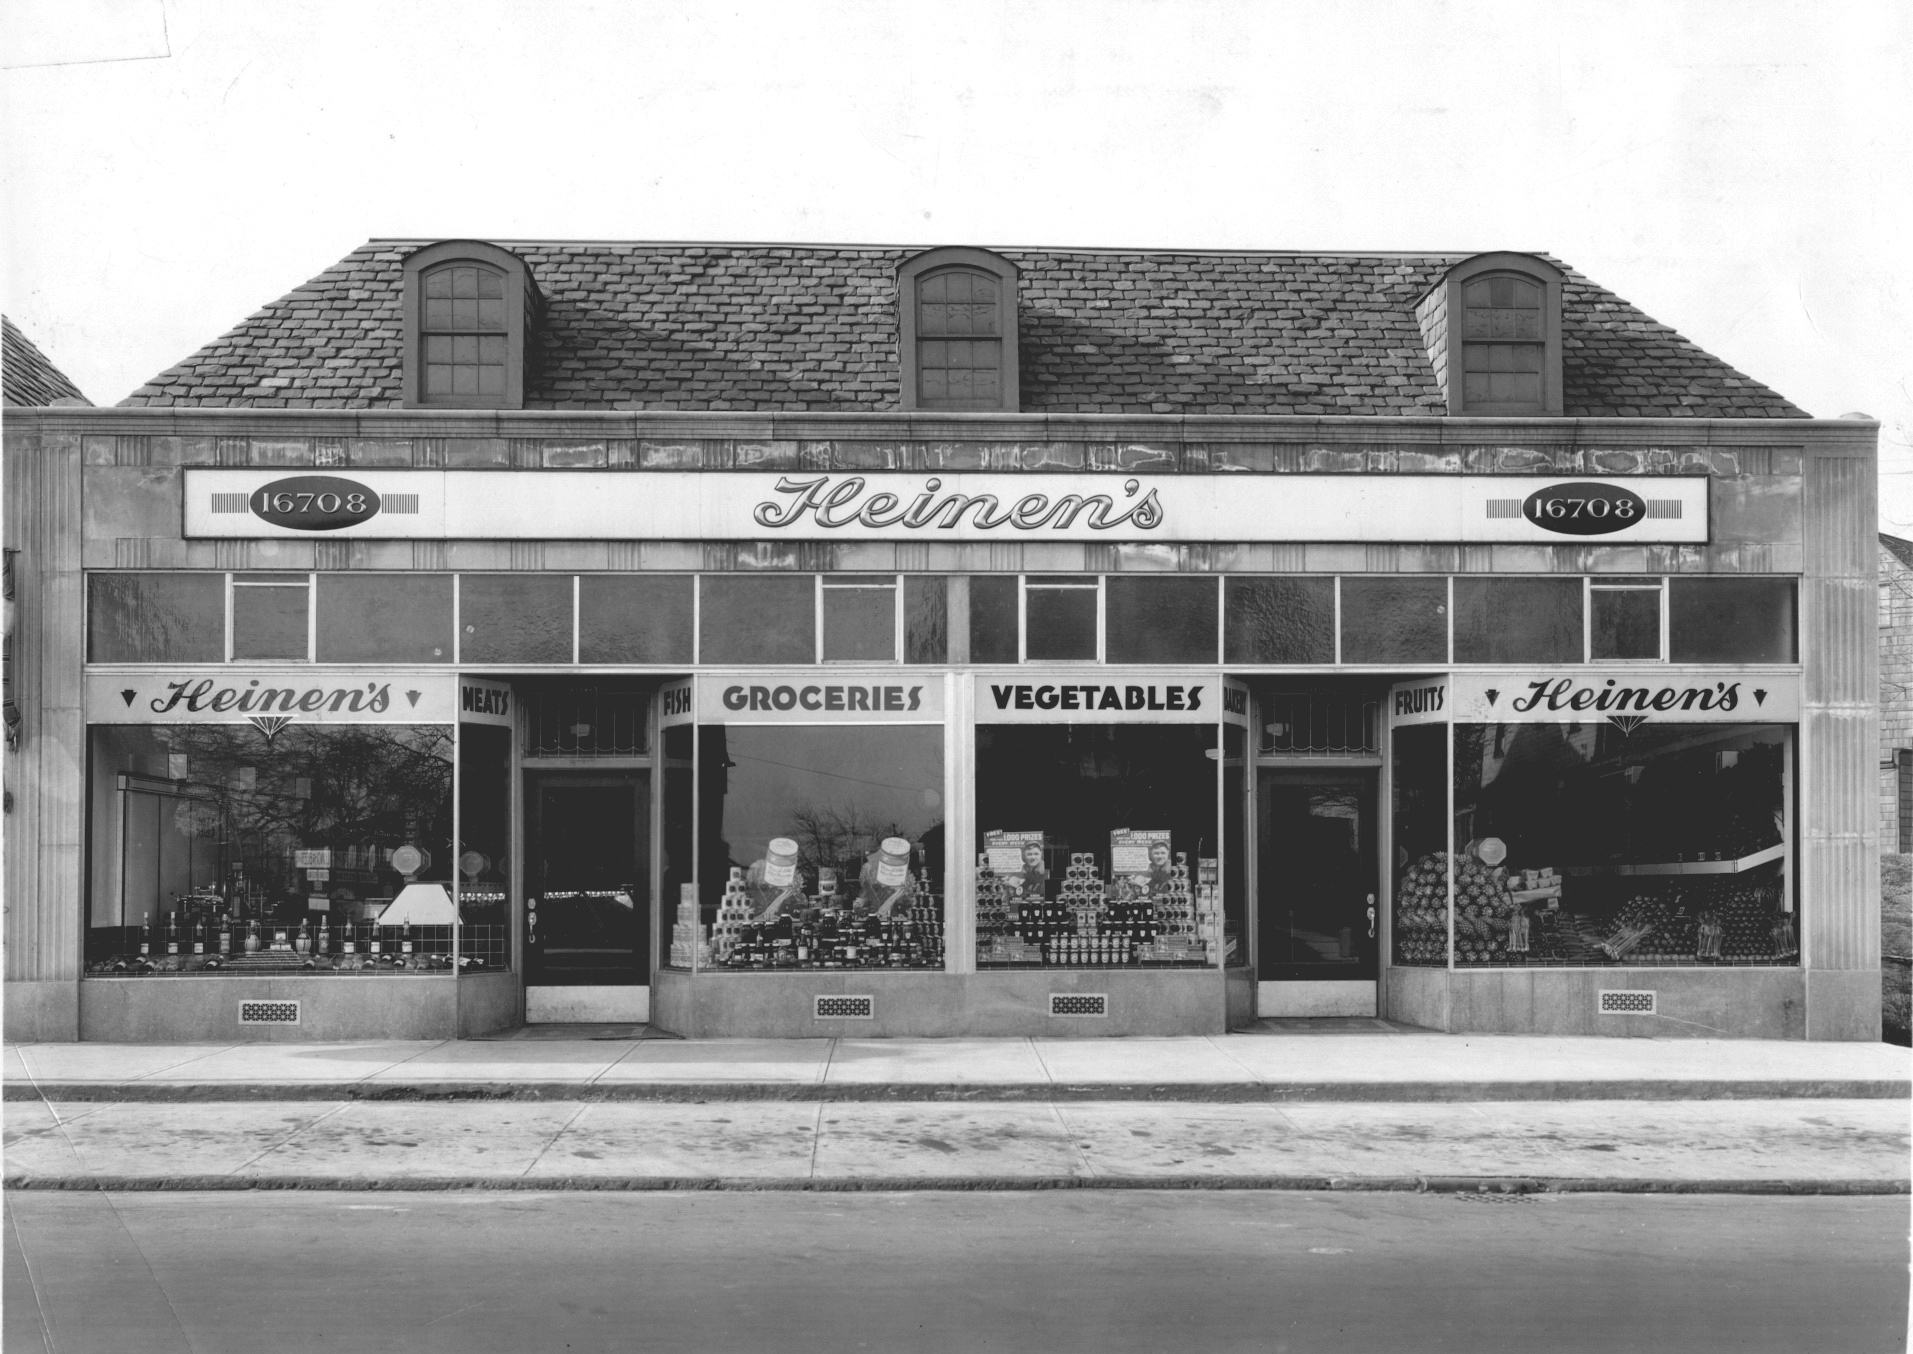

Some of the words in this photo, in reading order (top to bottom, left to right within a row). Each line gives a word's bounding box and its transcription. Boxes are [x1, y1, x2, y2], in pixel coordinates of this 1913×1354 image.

[261, 490, 368, 515] 16708
[753, 475, 1164, 530] Heinen's
[1534, 497, 1635, 520] 16708
[149, 678, 391, 714] Heinen's
[462, 685, 510, 716] MEATS
[663, 686, 691, 716] FISH
[722, 684, 924, 712] GROCERIES
[990, 684, 1205, 711] VEGETABLES
[1395, 685, 1444, 716] FRUITS
[1512, 678, 1740, 713] Heinen's
[1020, 833, 1043, 841] PRIZES
[1147, 832, 1170, 840] PRIZES
